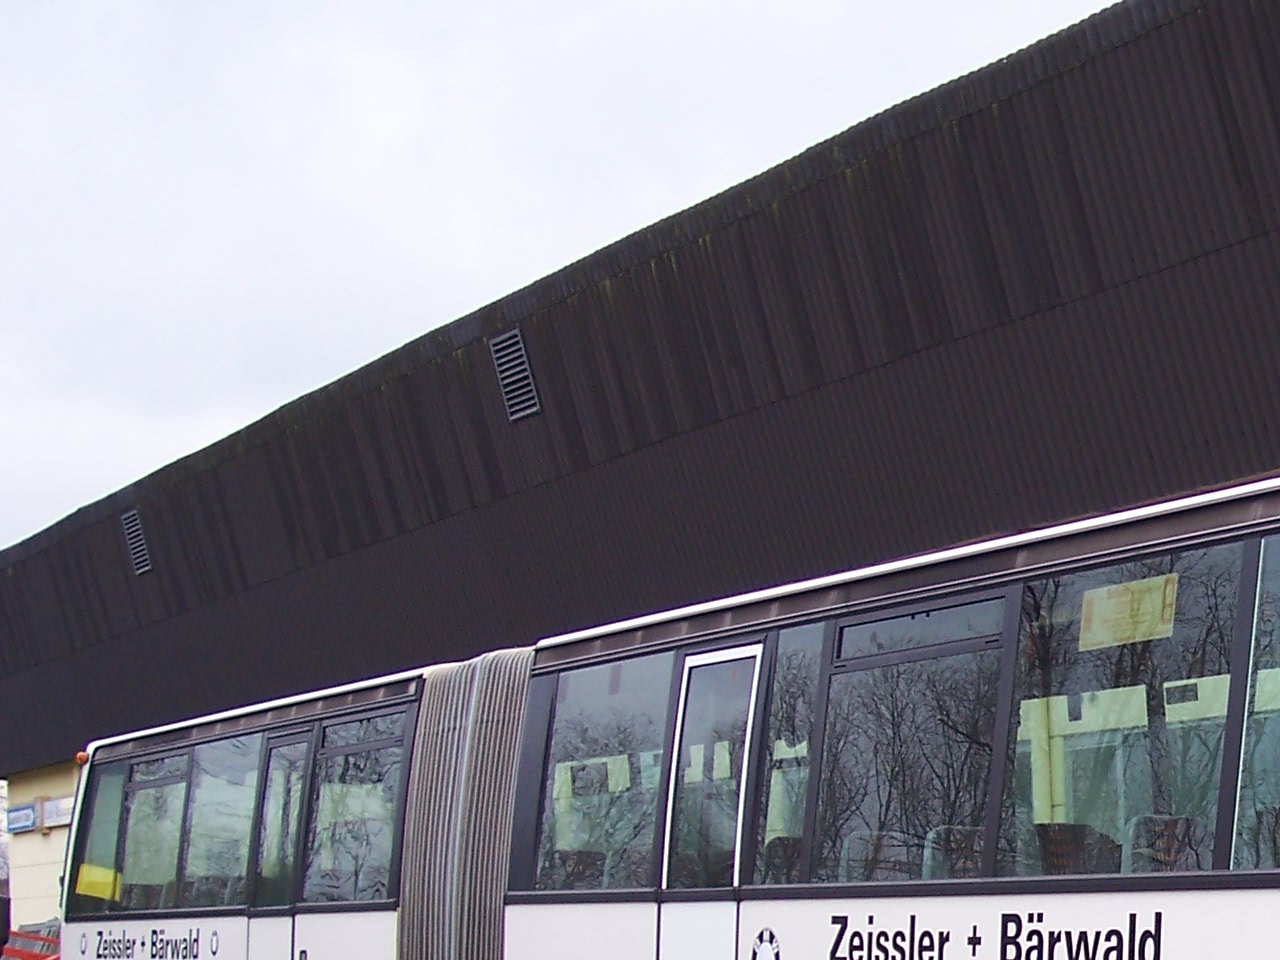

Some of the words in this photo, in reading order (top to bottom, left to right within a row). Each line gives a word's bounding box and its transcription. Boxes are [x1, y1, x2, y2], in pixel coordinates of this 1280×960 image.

[96, 930, 136, 959] Zeissler
[150, 928, 199, 960] Bärwald
[967, 925, 982, 957] +
